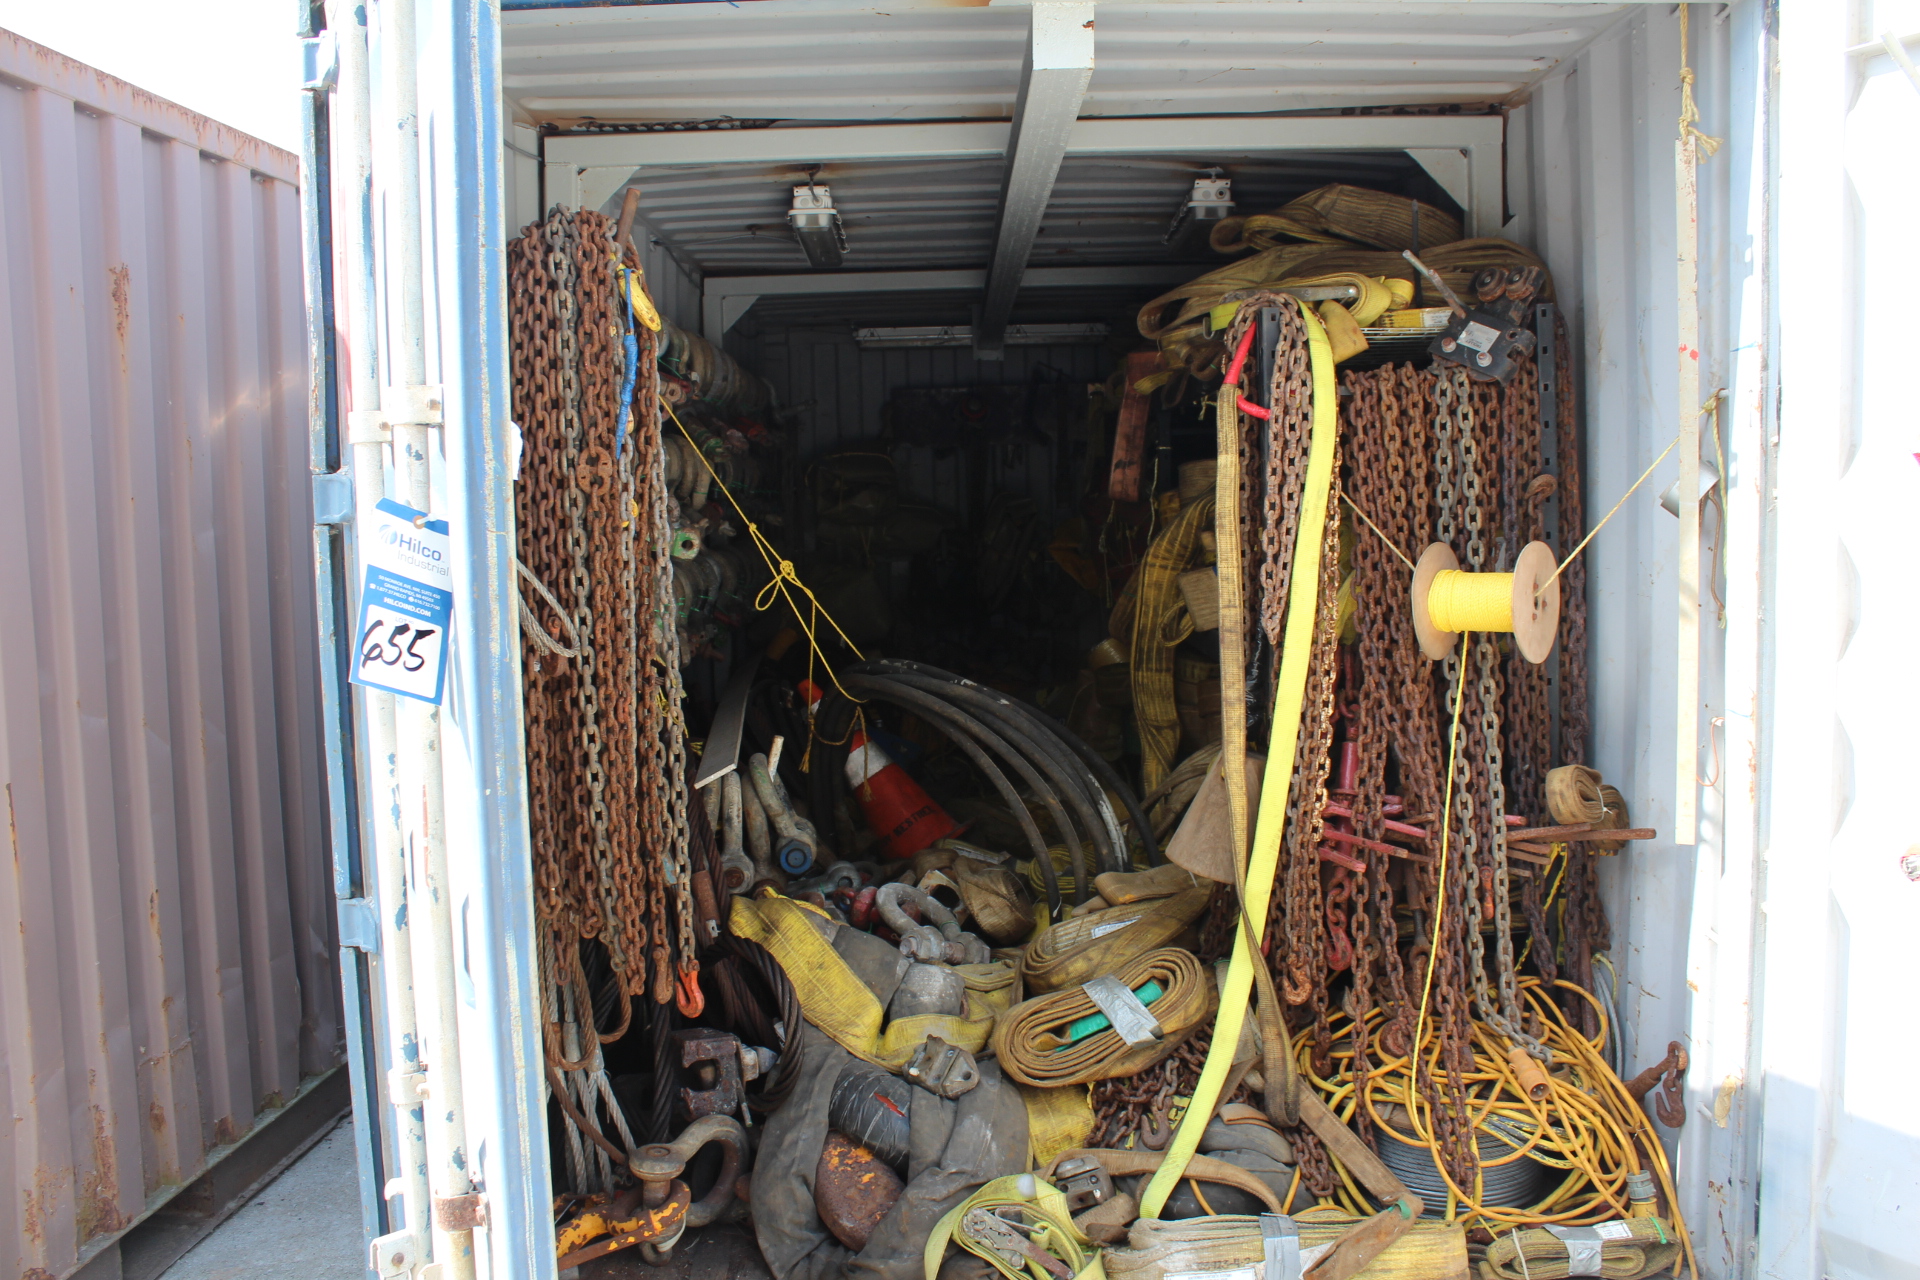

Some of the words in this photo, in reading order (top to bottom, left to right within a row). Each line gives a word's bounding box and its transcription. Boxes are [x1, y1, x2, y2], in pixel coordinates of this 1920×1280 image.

[399, 533, 442, 561] Hilco
[397, 550, 450, 577] Industrial
[383, 582, 400, 591] GRAND
[383, 596, 432, 617] HILCOIND.COM
[361, 619, 436, 672] 655
